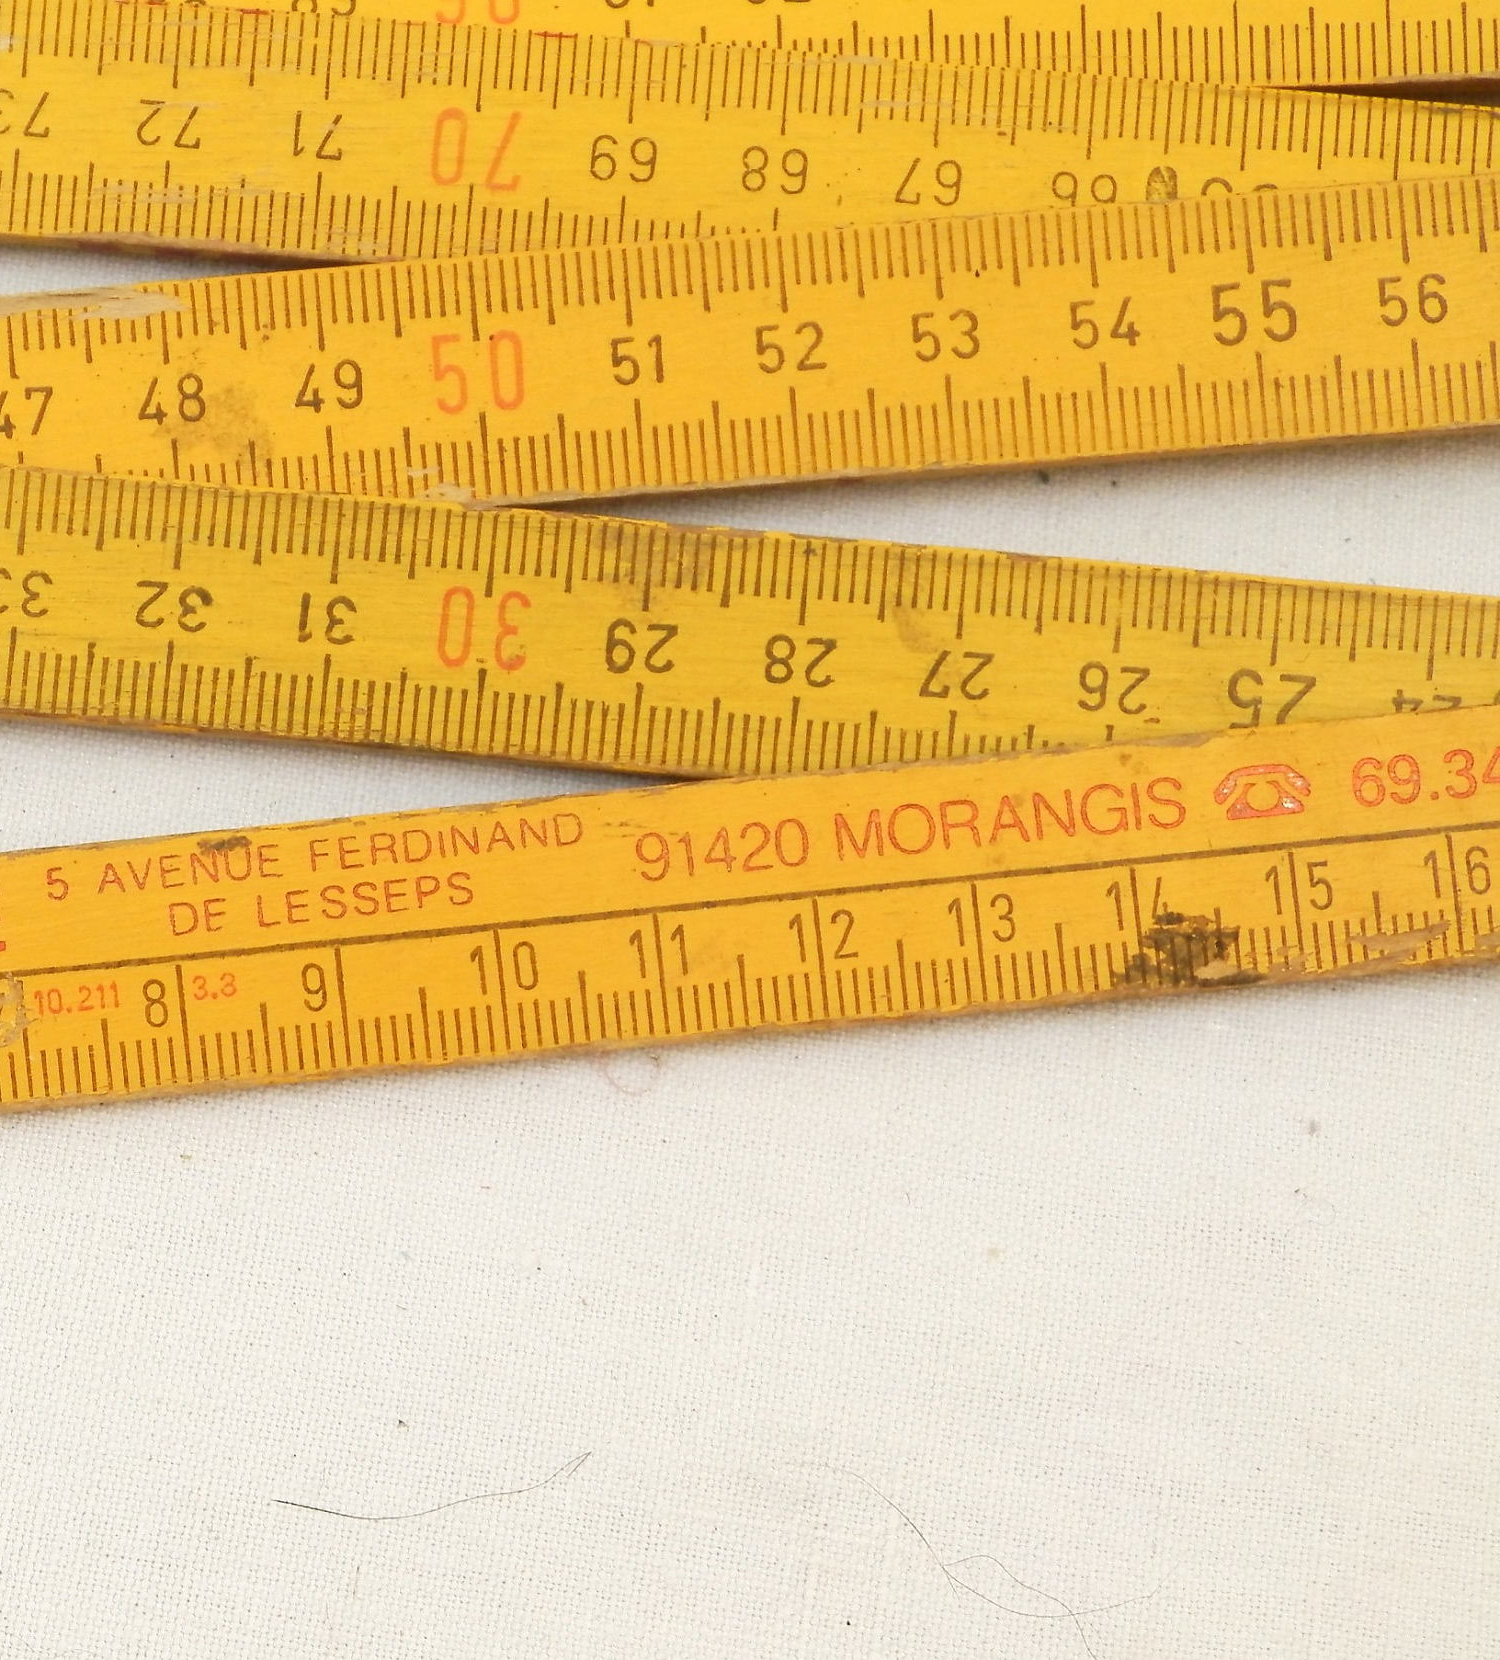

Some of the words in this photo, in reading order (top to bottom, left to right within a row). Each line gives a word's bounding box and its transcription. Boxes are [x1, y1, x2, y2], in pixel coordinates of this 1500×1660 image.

[135, 99, 202, 150] 72
[291, 109, 343, 162] 71
[430, 106, 522, 194] 70
[588, 133, 659, 184] 69
[740, 144, 810, 196] 68
[895, 156, 963, 207] 67
[138, 372, 207, 426] 48
[294, 358, 364, 414] 49
[430, 329, 526, 415] 50
[609, 333, 665, 386] 51
[755, 321, 828, 374] 52
[910, 308, 981, 362] 53
[1068, 295, 1141, 350] 54
[1210, 277, 1298, 347] 55
[1376, 272, 1449, 328] 56
[135, 578, 214, 634] 32
[297, 591, 359, 646] 31
[437, 585, 532, 672] 30
[604, 617, 680, 674] 29
[764, 633, 839, 689] 28
[918, 648, 996, 701] 27
[1078, 660, 1152, 716] 26
[1227, 667, 1318, 730] 25
[44, 865, 70, 901] 5
[97, 843, 284, 895] AVENUE
[308, 812, 584, 872] FERDINAND
[634, 817, 810, 882] 91420
[834, 776, 1187, 861] MORANGIS
[167, 897, 227, 937] DE
[256, 870, 475, 928] LESSEPS
[33, 980, 121, 1016] 10.211
[191, 971, 238, 1001] 3.3
[141, 977, 169, 1029] 8
[300, 961, 328, 1013] 9
